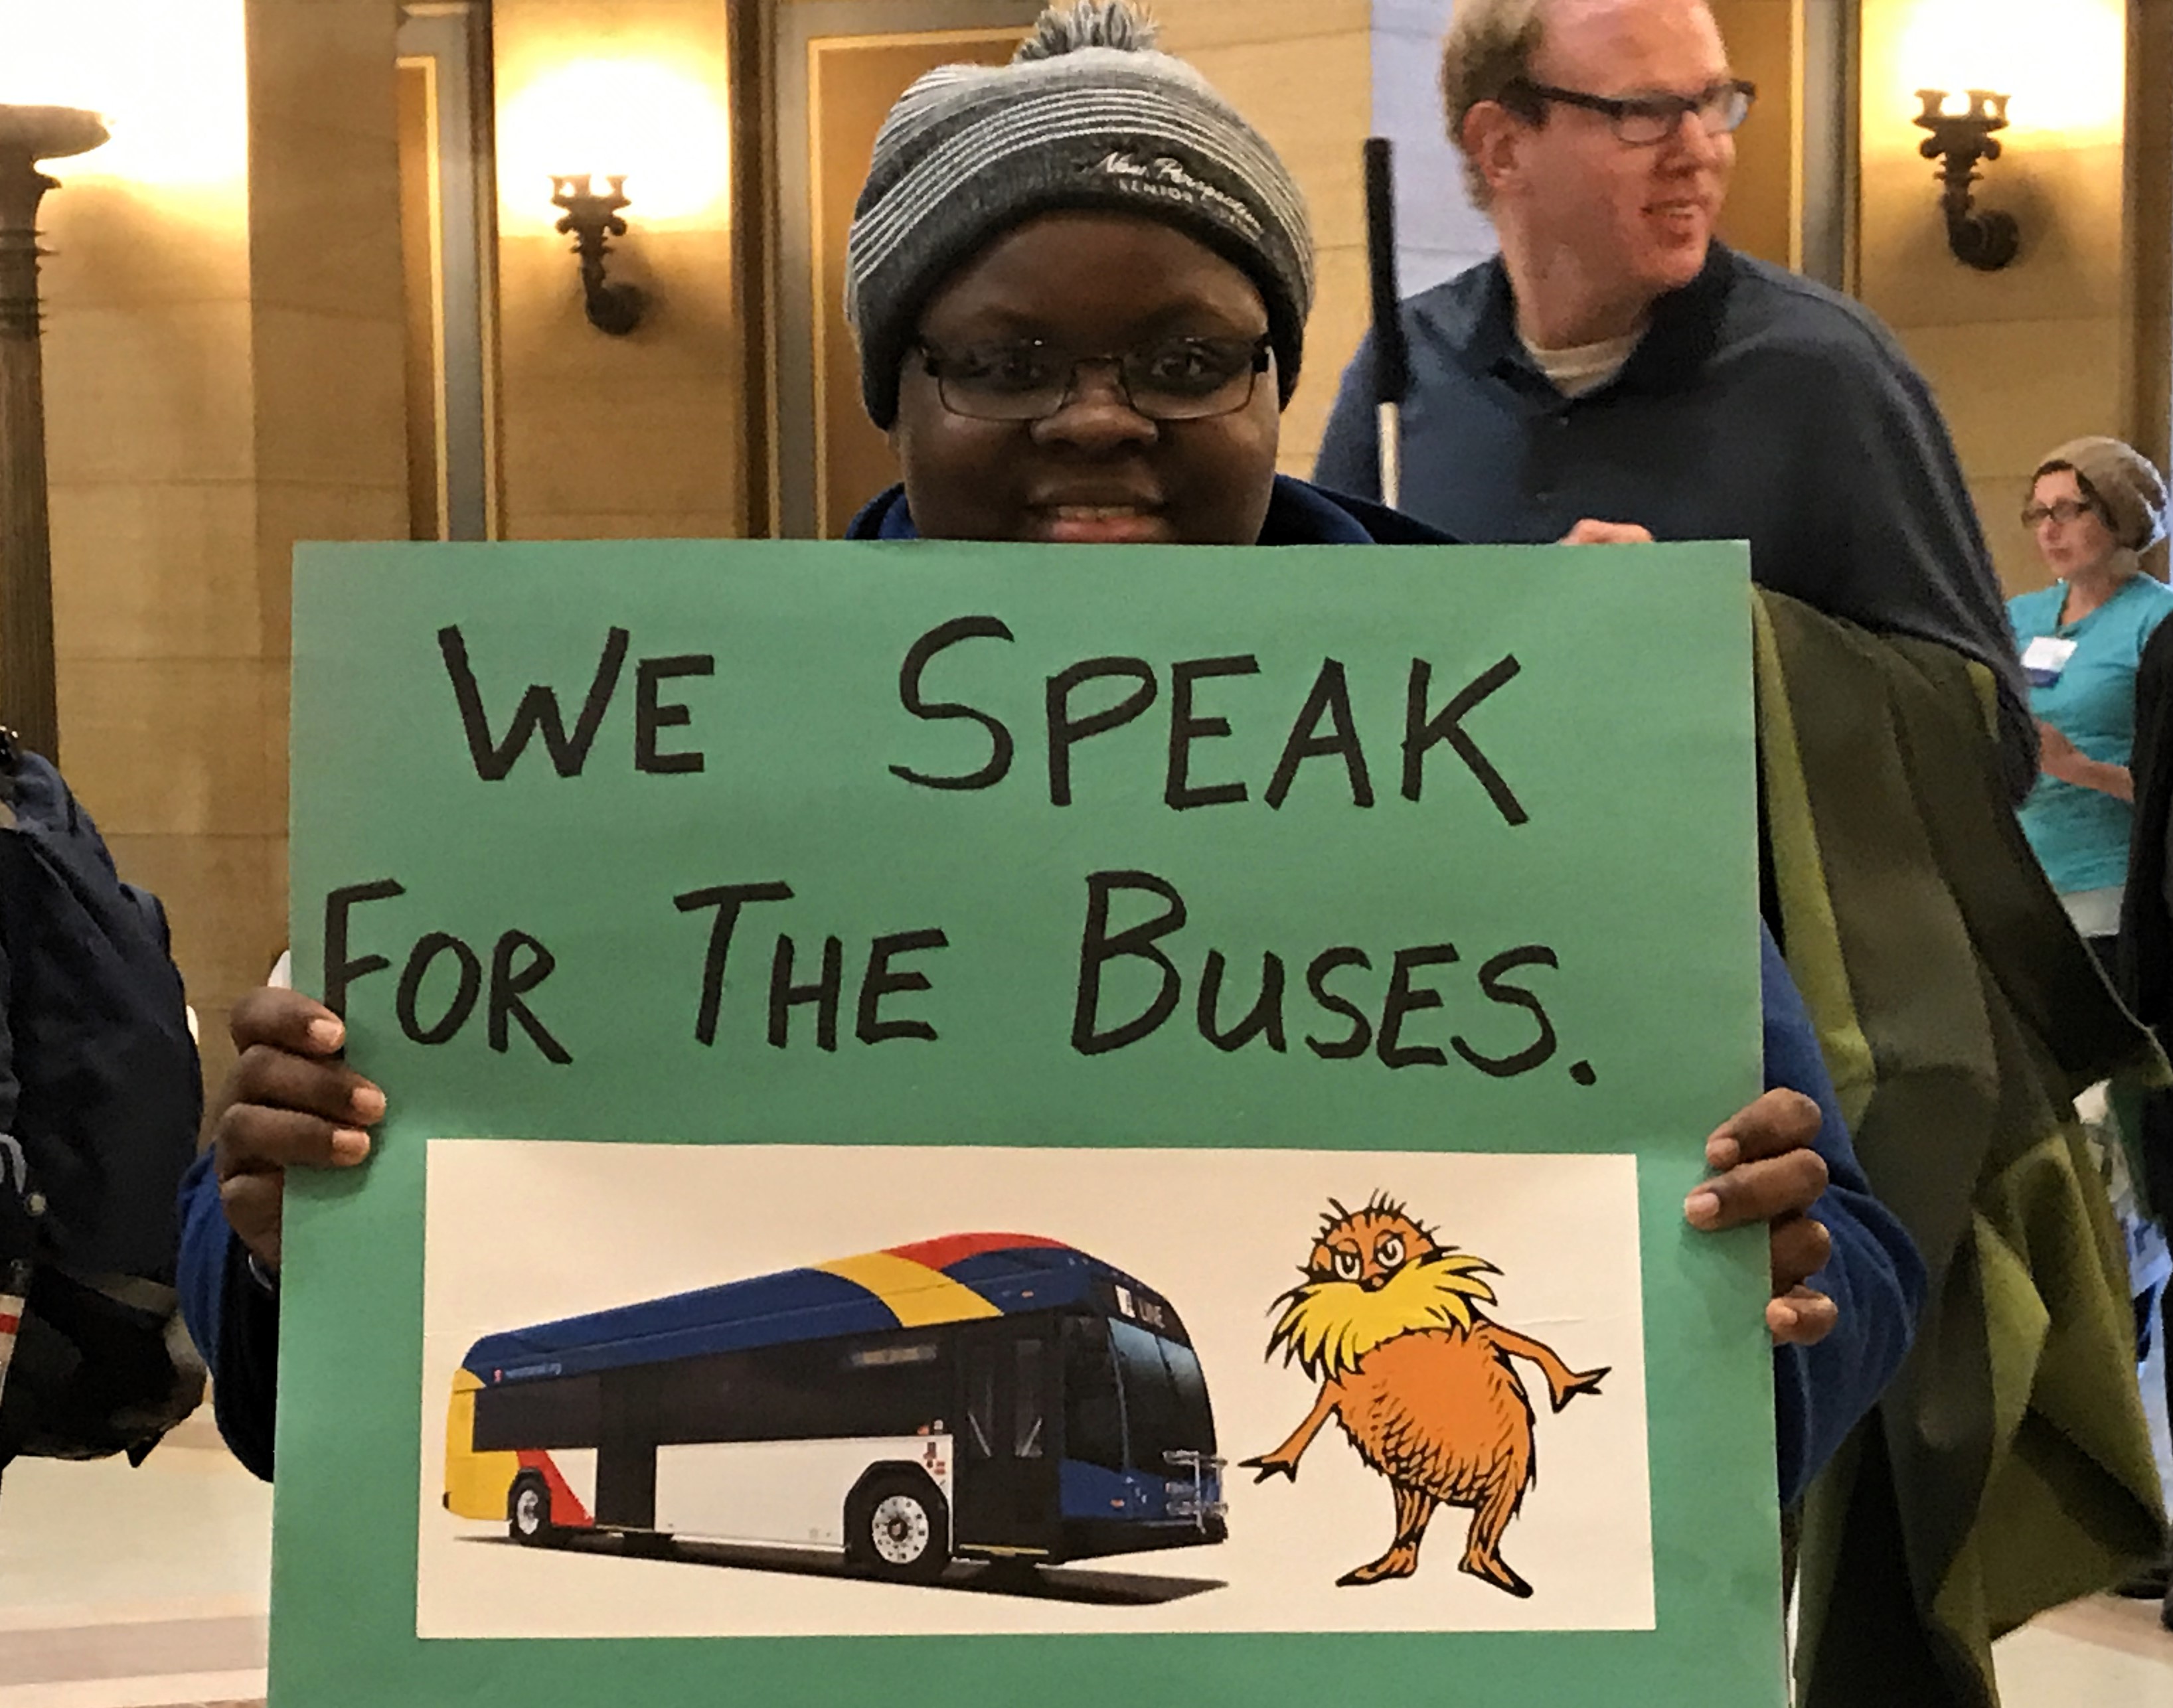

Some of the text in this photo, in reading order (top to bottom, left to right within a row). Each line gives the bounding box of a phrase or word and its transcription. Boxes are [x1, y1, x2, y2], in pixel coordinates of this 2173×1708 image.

[436, 614, 1530, 828] WE SPEAK
[322, 868, 1599, 1088] FOR THE BUSES.
